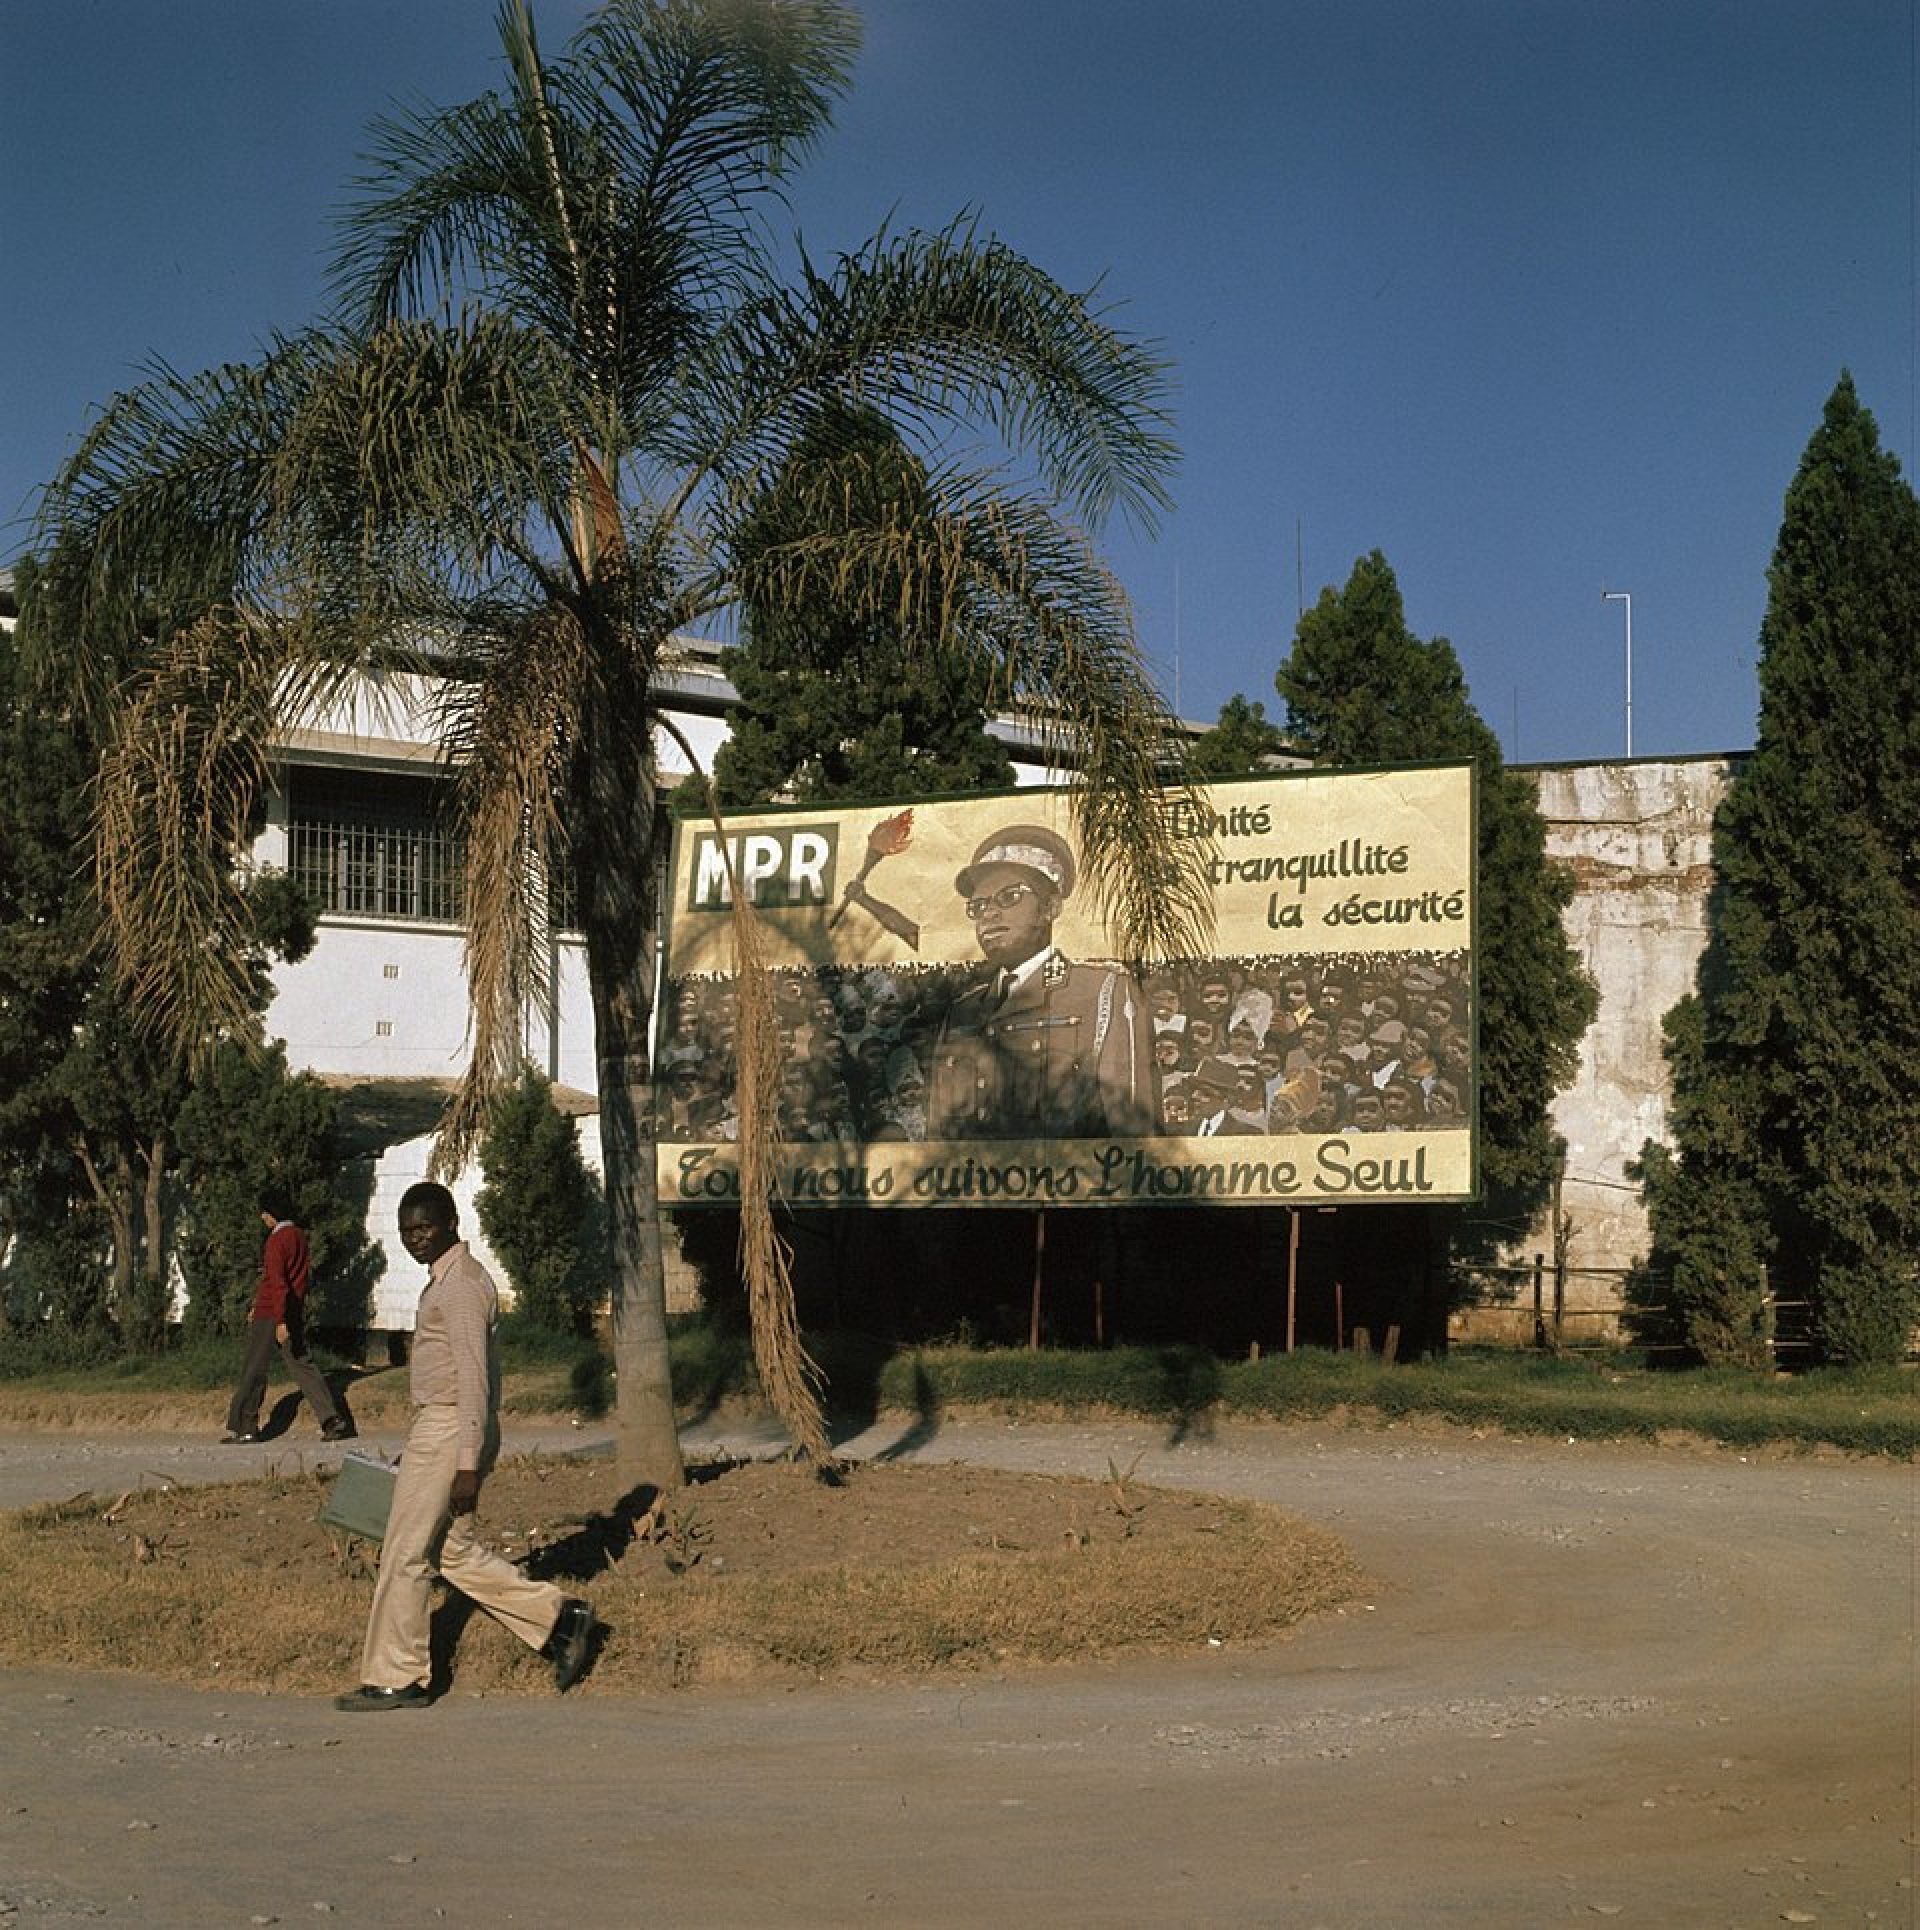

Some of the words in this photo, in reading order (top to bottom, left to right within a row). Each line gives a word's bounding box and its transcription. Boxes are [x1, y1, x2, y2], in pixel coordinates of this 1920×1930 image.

[695, 832, 830, 905] MPR
[1207, 838, 1409, 894] tranquillité
[1267, 891, 1304, 929] la
[1322, 889, 1466, 925] sécurité
[678, 1147, 770, 1198] To
[790, 1166, 895, 1197] nous
[913, 1157, 1079, 1198] suivons
[1086, 1145, 1302, 1198] L'homme
[1313, 1138, 1433, 1193] Seul
